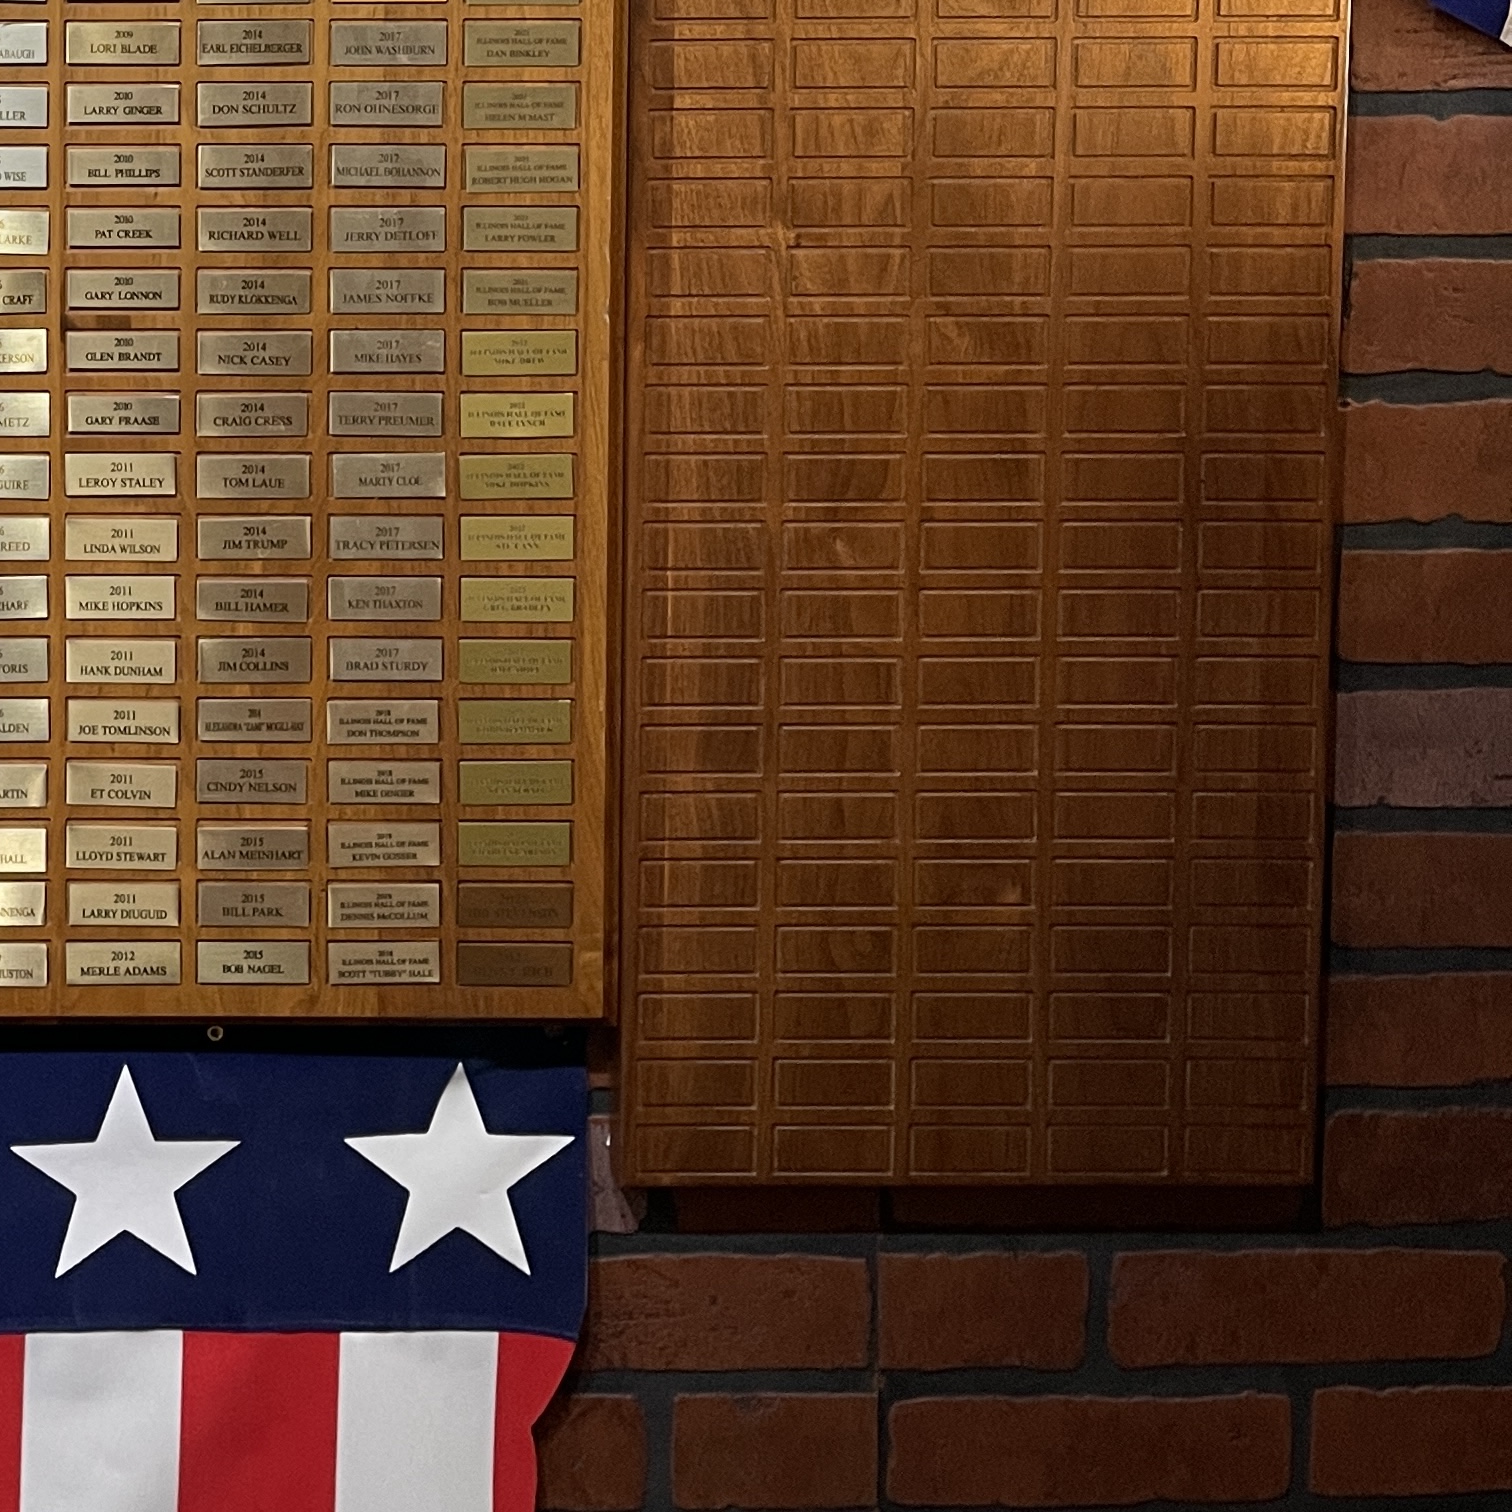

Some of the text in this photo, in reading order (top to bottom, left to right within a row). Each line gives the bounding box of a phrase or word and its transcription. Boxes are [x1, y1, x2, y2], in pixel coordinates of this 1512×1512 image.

[243, 342, 266, 352] 2014
[218, 355, 291, 365] NICK CASEY
[375, 648, 399, 658] 2017
[346, 661, 428, 671] BRAD STURDY
[111, 951, 135, 961] 2012
[80, 967, 167, 976] MERLE ADAMS
